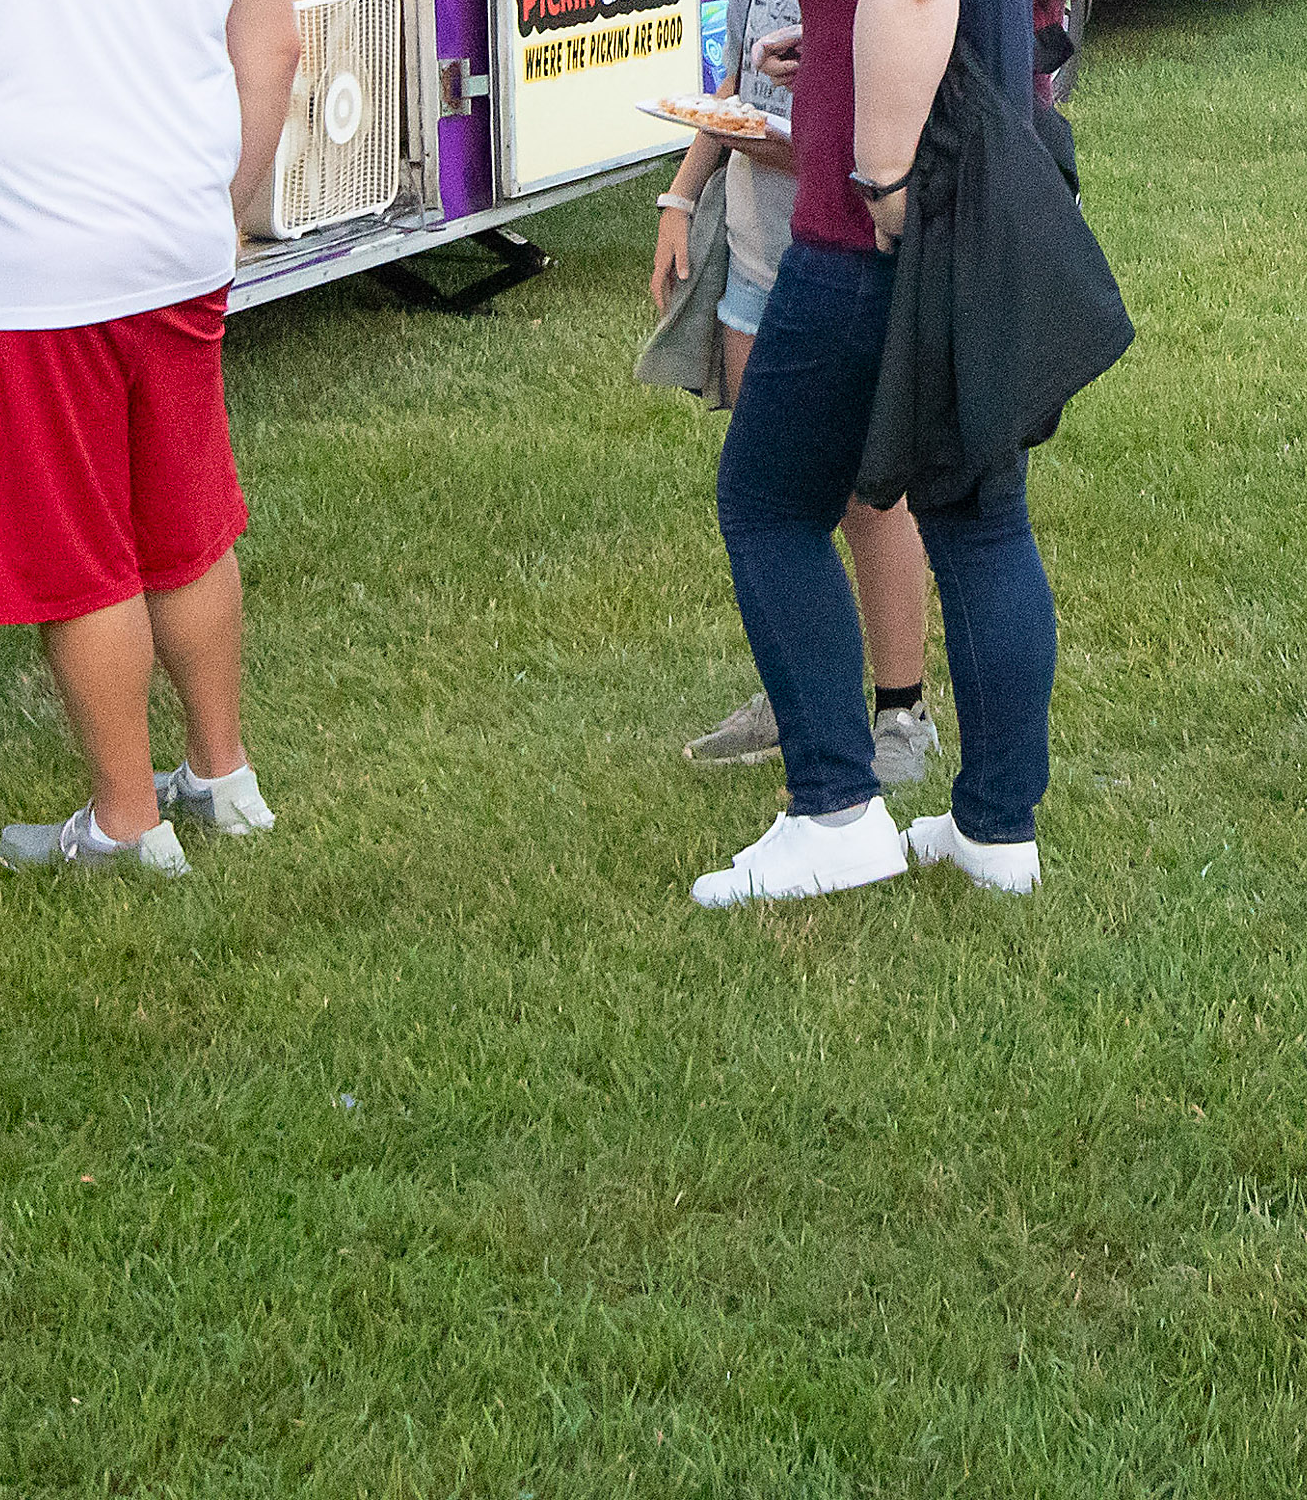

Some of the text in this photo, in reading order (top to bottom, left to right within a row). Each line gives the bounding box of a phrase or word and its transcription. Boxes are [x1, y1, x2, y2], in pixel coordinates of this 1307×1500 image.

[525, 16, 683, 80] WHERE THE PICKINS ARE GOOD
